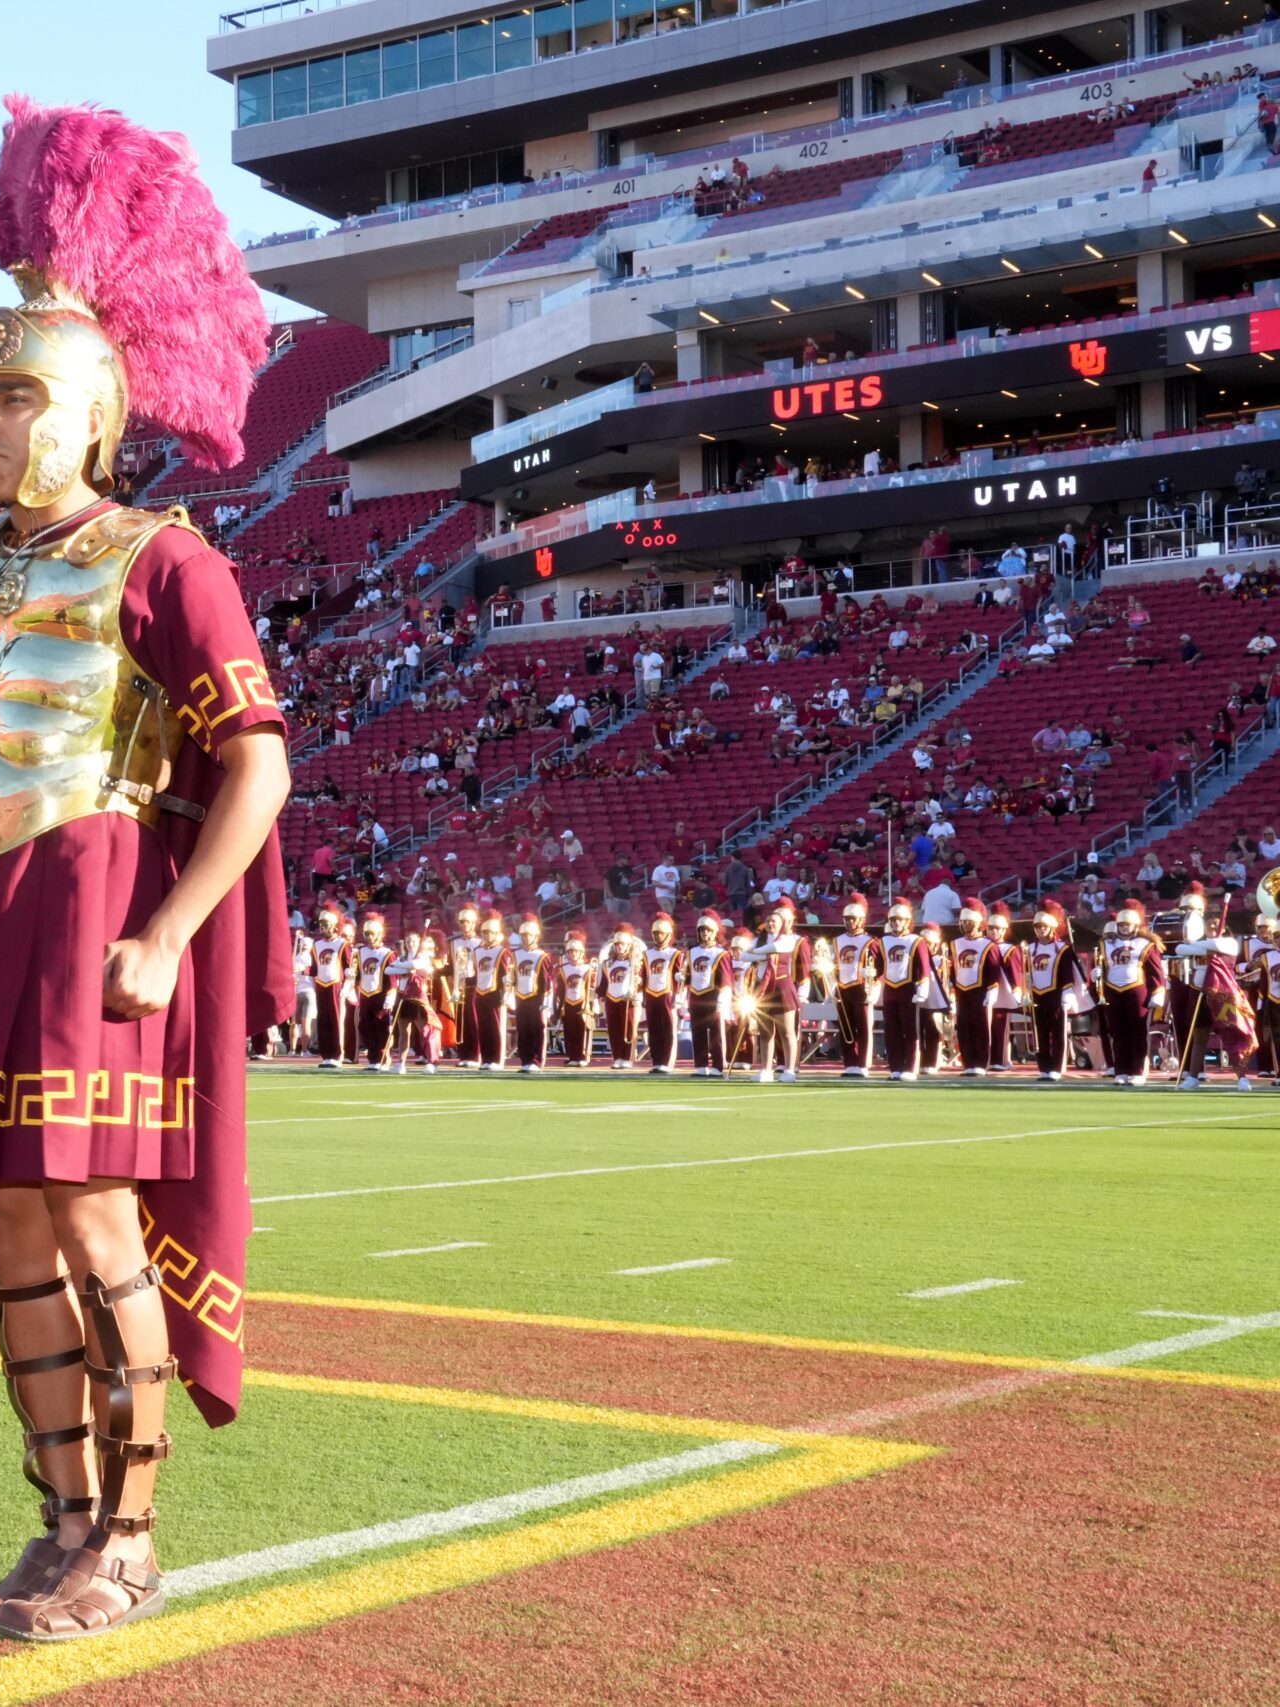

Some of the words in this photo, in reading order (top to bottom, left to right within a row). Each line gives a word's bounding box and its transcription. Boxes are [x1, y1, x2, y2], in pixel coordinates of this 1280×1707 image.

[1080, 82, 1113, 101] 403
[799, 141, 828, 158] 402
[613, 179, 635, 195] 401
[1185, 325, 1233, 355] VS
[773, 375, 883, 419] UTES
[513, 449, 551, 473] UTAH
[974, 475, 1077, 506] UTAH
